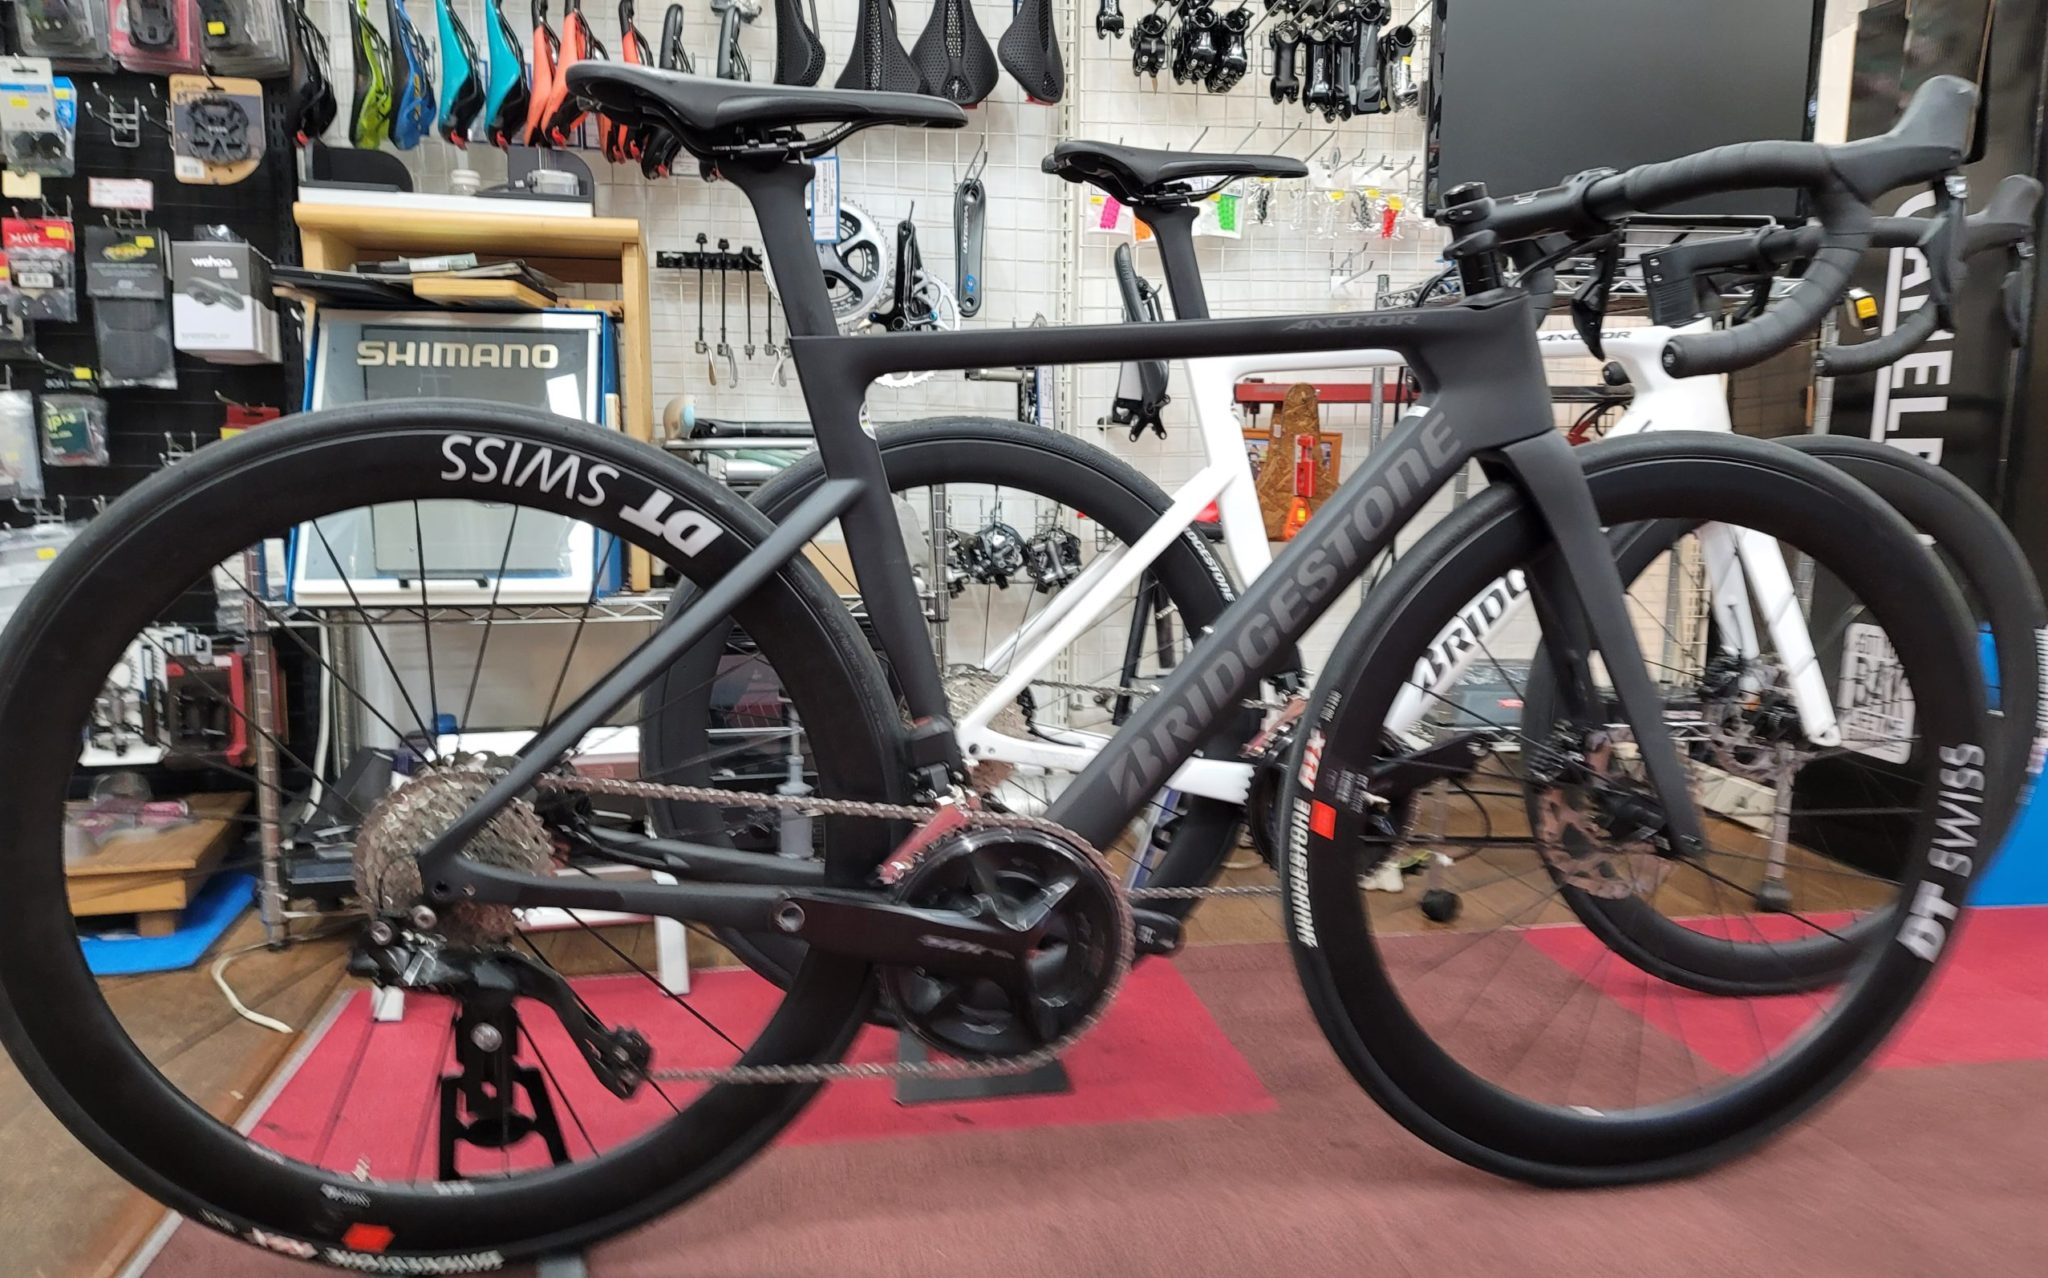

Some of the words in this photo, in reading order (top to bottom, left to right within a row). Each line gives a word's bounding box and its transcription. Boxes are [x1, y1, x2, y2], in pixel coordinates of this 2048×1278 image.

[357, 341, 559, 368] SHIMANO
[1281, 315, 1420, 332] ANCHOR
[1536, 331, 1632, 341] ANCOR
[441, 434, 620, 507] SWISS
[619, 488, 724, 558] DT
[1107, 411, 1462, 801] BRIDGESTONE
[1927, 743, 1986, 878] SWISS
[1289, 797, 1318, 948] BRIDGESTONE
[1896, 880, 1960, 963] DT
